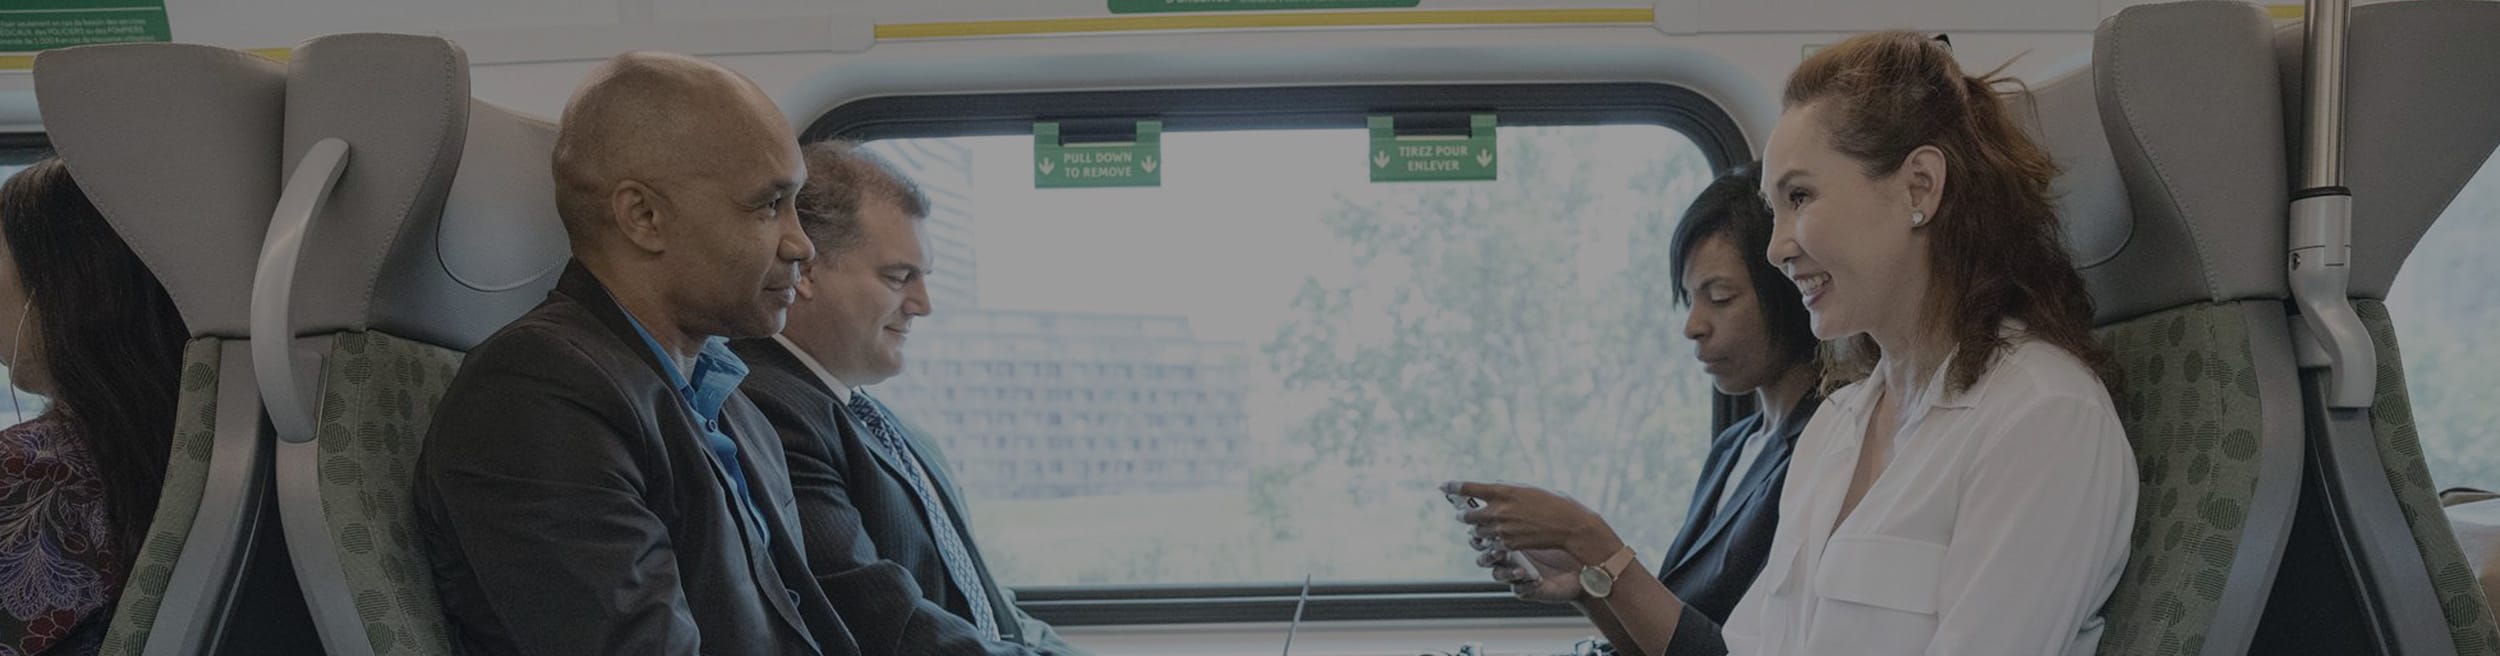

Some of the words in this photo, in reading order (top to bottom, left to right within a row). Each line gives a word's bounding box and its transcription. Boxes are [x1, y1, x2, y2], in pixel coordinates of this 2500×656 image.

[1063, 152, 1092, 163] PULL
[1095, 151, 1132, 163] DOWN
[1399, 146, 1432, 157] TIREZ
[1436, 145, 1468, 157] POUR
[1064, 167, 1080, 177] TO
[1083, 166, 1132, 177] REMOVE
[1407, 160, 1460, 172] ENLEVER
